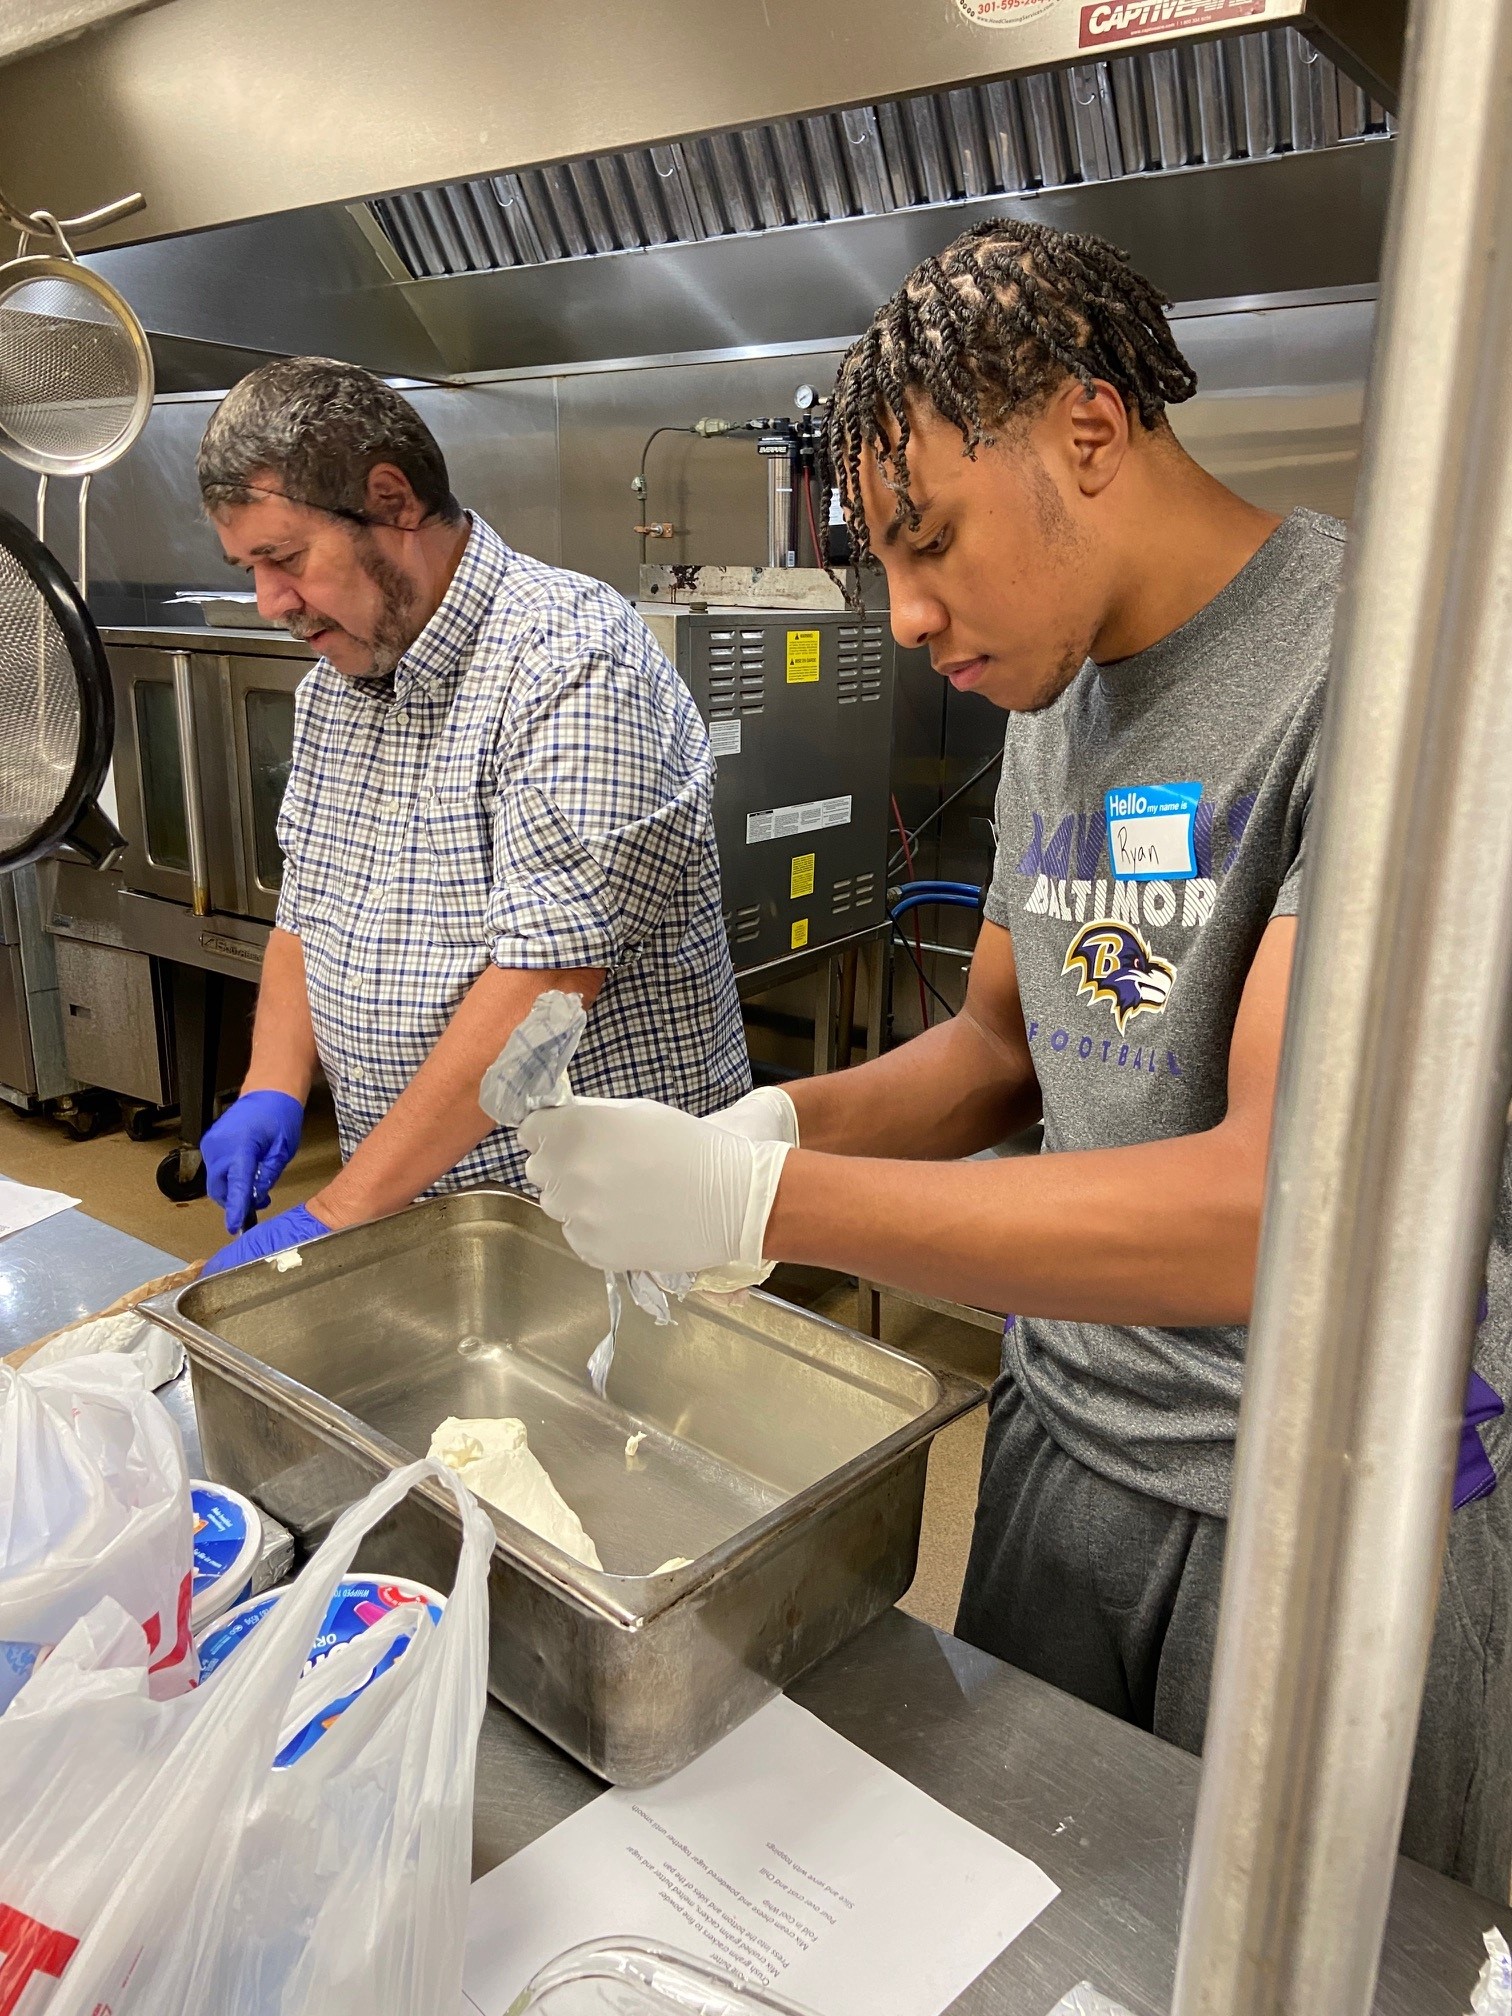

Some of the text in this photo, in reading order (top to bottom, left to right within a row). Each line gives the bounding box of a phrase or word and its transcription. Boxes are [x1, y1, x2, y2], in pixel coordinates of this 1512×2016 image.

[1109, 792, 1188, 817] Hello my name is
[1117, 826, 1159, 874] Ryan
[1023, 874, 1218, 927] BALTIMOR
[1082, 933, 1124, 980] B
[1028, 1020, 1183, 1076] FOOTBALL
[342, 1589, 370, 1598] WHIPPED
[625, 1845, 644, 1860] sugar
[640, 1858, 654, 1870] and
[764, 1840, 855, 1910] Slice and serve with toppings
[630, 1804, 809, 1951] Mix cream cheese and powdered sugar together until smooth
[652, 1869, 674, 1888] butter
[656, 1890, 684, 1912] powder
[670, 1886, 696, 1906] melted
[758, 1866, 836, 1925] Pour over crust and Chill
[662, 1860, 790, 1968] Press into the bottom and sides of the pan
[680, 1910, 696, 1925] fine
[761, 1898, 818, 1942] Fold in Cool Whip
[693, 1922, 703, 1932] to
[701, 1928, 730, 1953] crackers
[710, 1952, 731, 1970] butter
[738, 1942, 766, 1964] crushed
[748, 1964, 770, 1986] Crush
[764, 1962, 780, 1978] Mix
